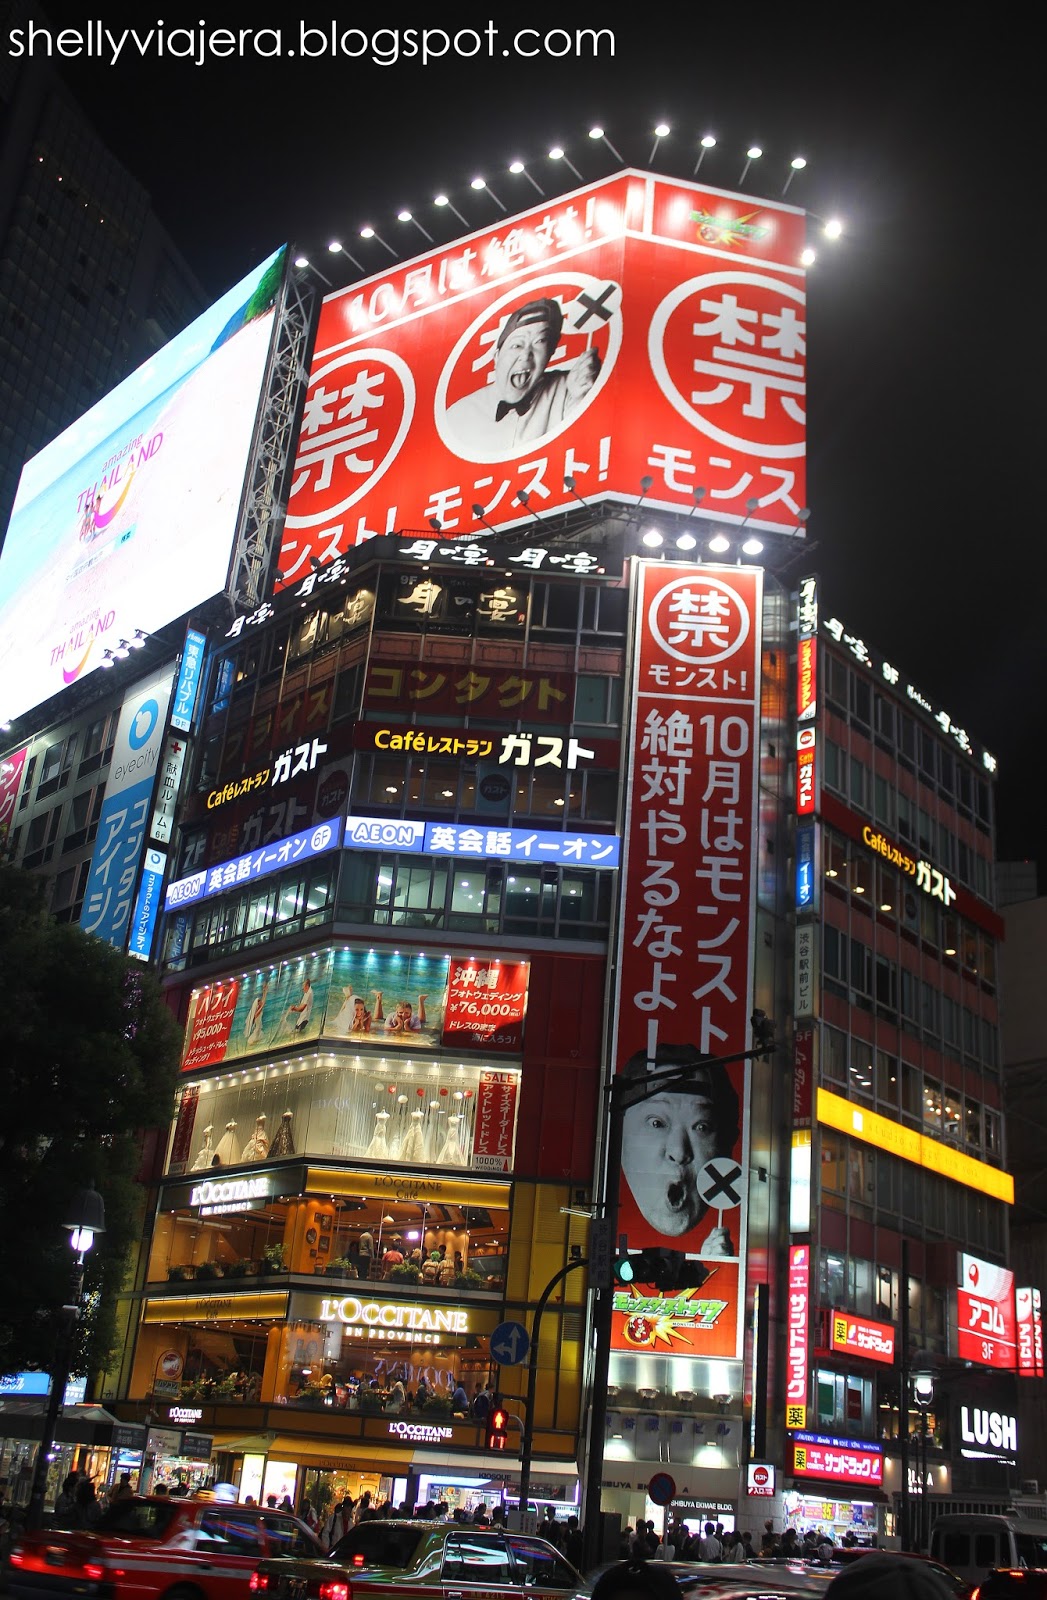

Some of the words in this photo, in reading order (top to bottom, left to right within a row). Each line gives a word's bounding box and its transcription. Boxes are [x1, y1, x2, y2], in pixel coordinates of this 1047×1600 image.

[691, 293, 806, 420] 禁
[290, 368, 386, 498] 禁
[101, 433, 144, 474] amazing
[76, 432, 164, 514] THAILAND
[424, 437, 612, 531] モンスト!
[648, 444, 800, 516] モンス
[668, 588, 731, 648] 禁
[50, 609, 116, 667] THAILAND
[176, 644, 200, 715] 東急リバブル
[367, 667, 568, 711] コンタクト
[648, 664, 747, 692] モンスト!
[882, 662, 899, 685] 9F
[115, 747, 159, 781] eyecity
[271, 737, 328, 787] ガスト
[499, 733, 595, 770] ガスト
[157, 762, 178, 829] 献血ルーム
[800, 764, 813, 807] ガスト
[313, 828, 330, 847] 6F
[354, 823, 415, 844] AEON
[430, 826, 614, 861] 英会話イーオン
[110, 797, 149, 945] コンタク
[208, 837, 307, 893] 英会話イーオン
[916, 859, 957, 906] ガスト
[170, 878, 201, 904] AEON
[633, 708, 694, 1072] 絶対やるなよ!
[692, 714, 749, 1055] 10月はモンスト
[452, 966, 500, 990] 沖縄
[799, 932, 810, 1011] 渋谷駅前ビル
[198, 987, 235, 1015] ハワイ
[484, 1072, 514, 1083] SALE
[478, 1084, 494, 1154] アウトレットドレス
[475, 1156, 503, 1166] 1000%
[374, 1175, 443, 1192] L'OCCITANE
[320, 1297, 468, 1333] L'OCCITANE
[968, 1298, 1006, 1336] アコム
[346, 1326, 363, 1337] EN
[369, 1328, 441, 1344] PROVENCE
[788, 1293, 807, 1399] サンドラッグ
[981, 1341, 994, 1360] 3F
[1019, 1323, 1032, 1358] アコム
[388, 1421, 453, 1438] L'OCCITANE
[788, 1407, 804, 1426] 薬
[961, 1405, 1017, 1451] LUSH
[478, 1472, 512, 1481] KIOSQUE
[825, 1453, 871, 1477] サンドラッグ
[671, 1499, 695, 1508] SHIBUYA
